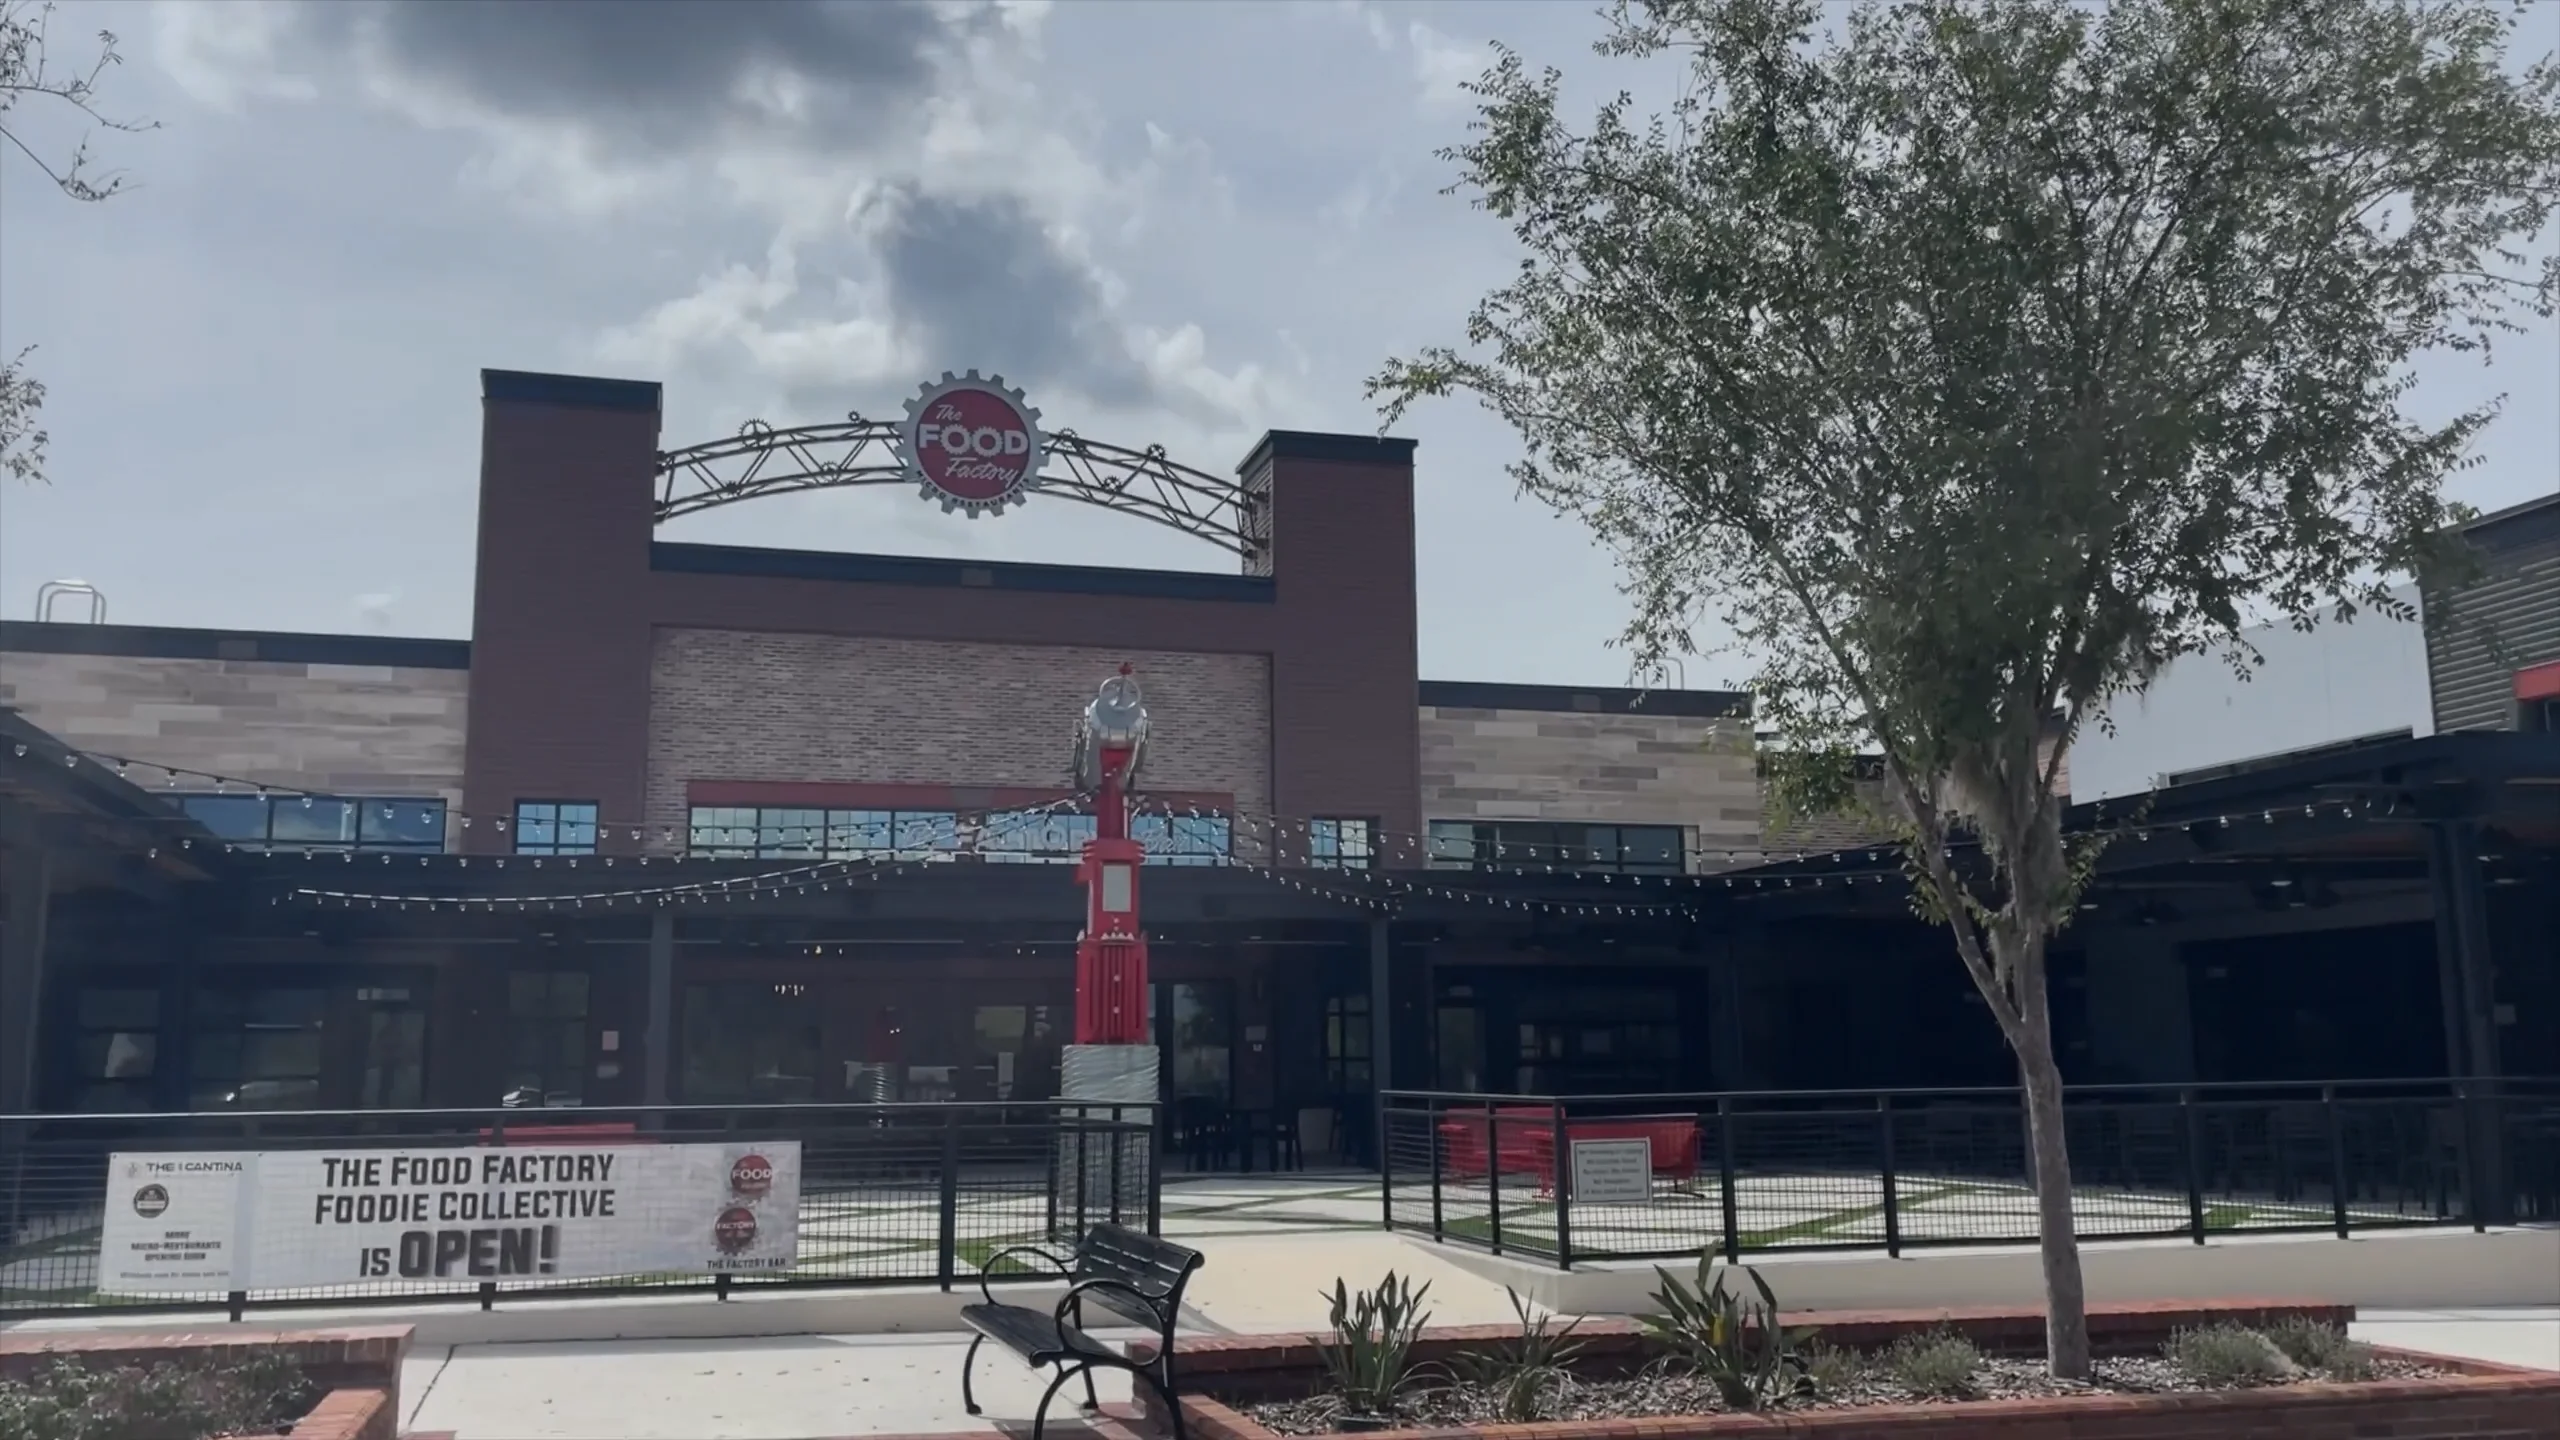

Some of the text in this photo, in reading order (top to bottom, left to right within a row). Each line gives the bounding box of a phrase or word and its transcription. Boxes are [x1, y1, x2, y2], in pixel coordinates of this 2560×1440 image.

[936, 404, 963, 421] The
[919, 424, 1029, 458] FOOD
[945, 457, 1020, 489] Factory
[146, 1162, 175, 1172] THE
[185, 1162, 243, 1172] CANTINA
[322, 1154, 614, 1187] THE FOOD FACTORY
[732, 1168, 773, 1180] FOOD
[315, 1189, 616, 1224] FOODIE COLLECTIVE
[360, 1225, 556, 1278] IS OPEN!
[707, 1258, 786, 1270] THE FACTORY BAR
